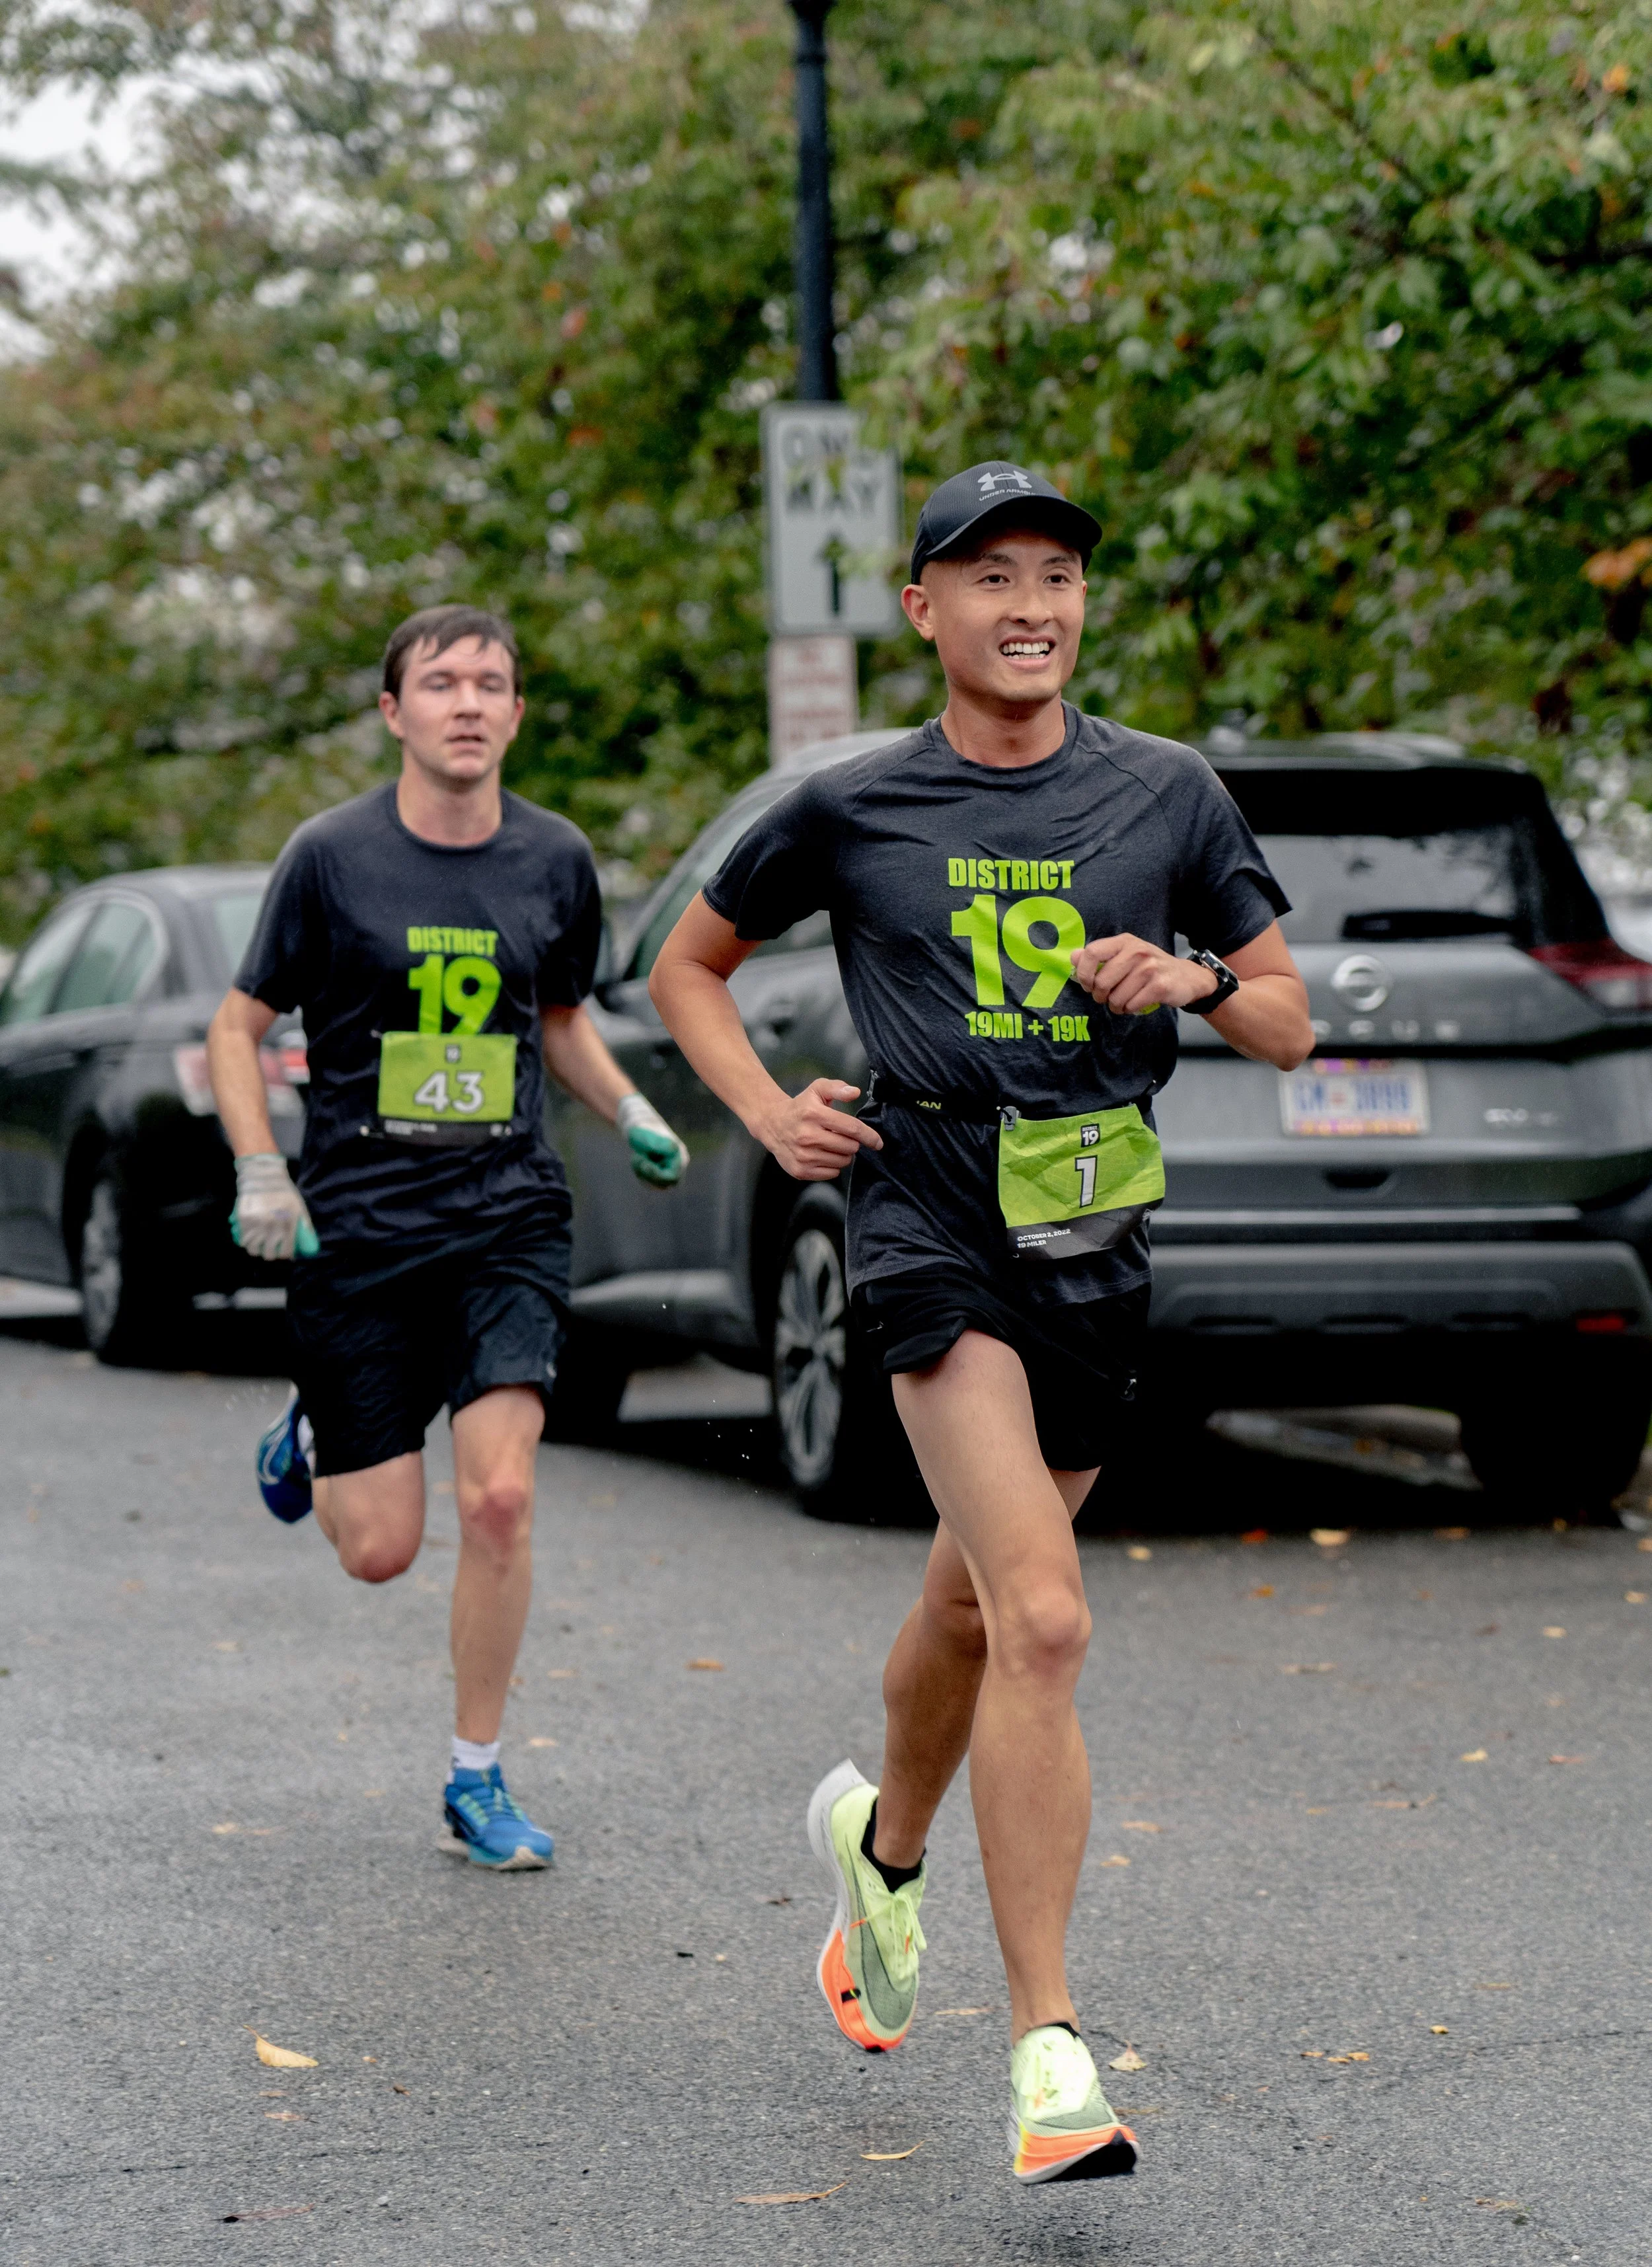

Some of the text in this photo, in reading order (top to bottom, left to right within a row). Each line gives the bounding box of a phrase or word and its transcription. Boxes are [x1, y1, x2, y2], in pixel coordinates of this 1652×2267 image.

[979, 489, 1006, 502] UNDER
[948, 858, 1075, 890] DISTRICT
[407, 926, 498, 957] DISTRICT
[951, 894, 1086, 1009] 19
[408, 954, 503, 1036] 19
[965, 1011, 1092, 1042] 19MI + 19K
[414, 1070, 484, 1114] 43
[917, 1100, 942, 1110] AN
[1082, 1130, 1100, 1146] 19
[1075, 1155, 1098, 1209] 1
[1017, 1233, 1047, 1242] OCTOBER
[1053, 1228, 1071, 1237] 2022
